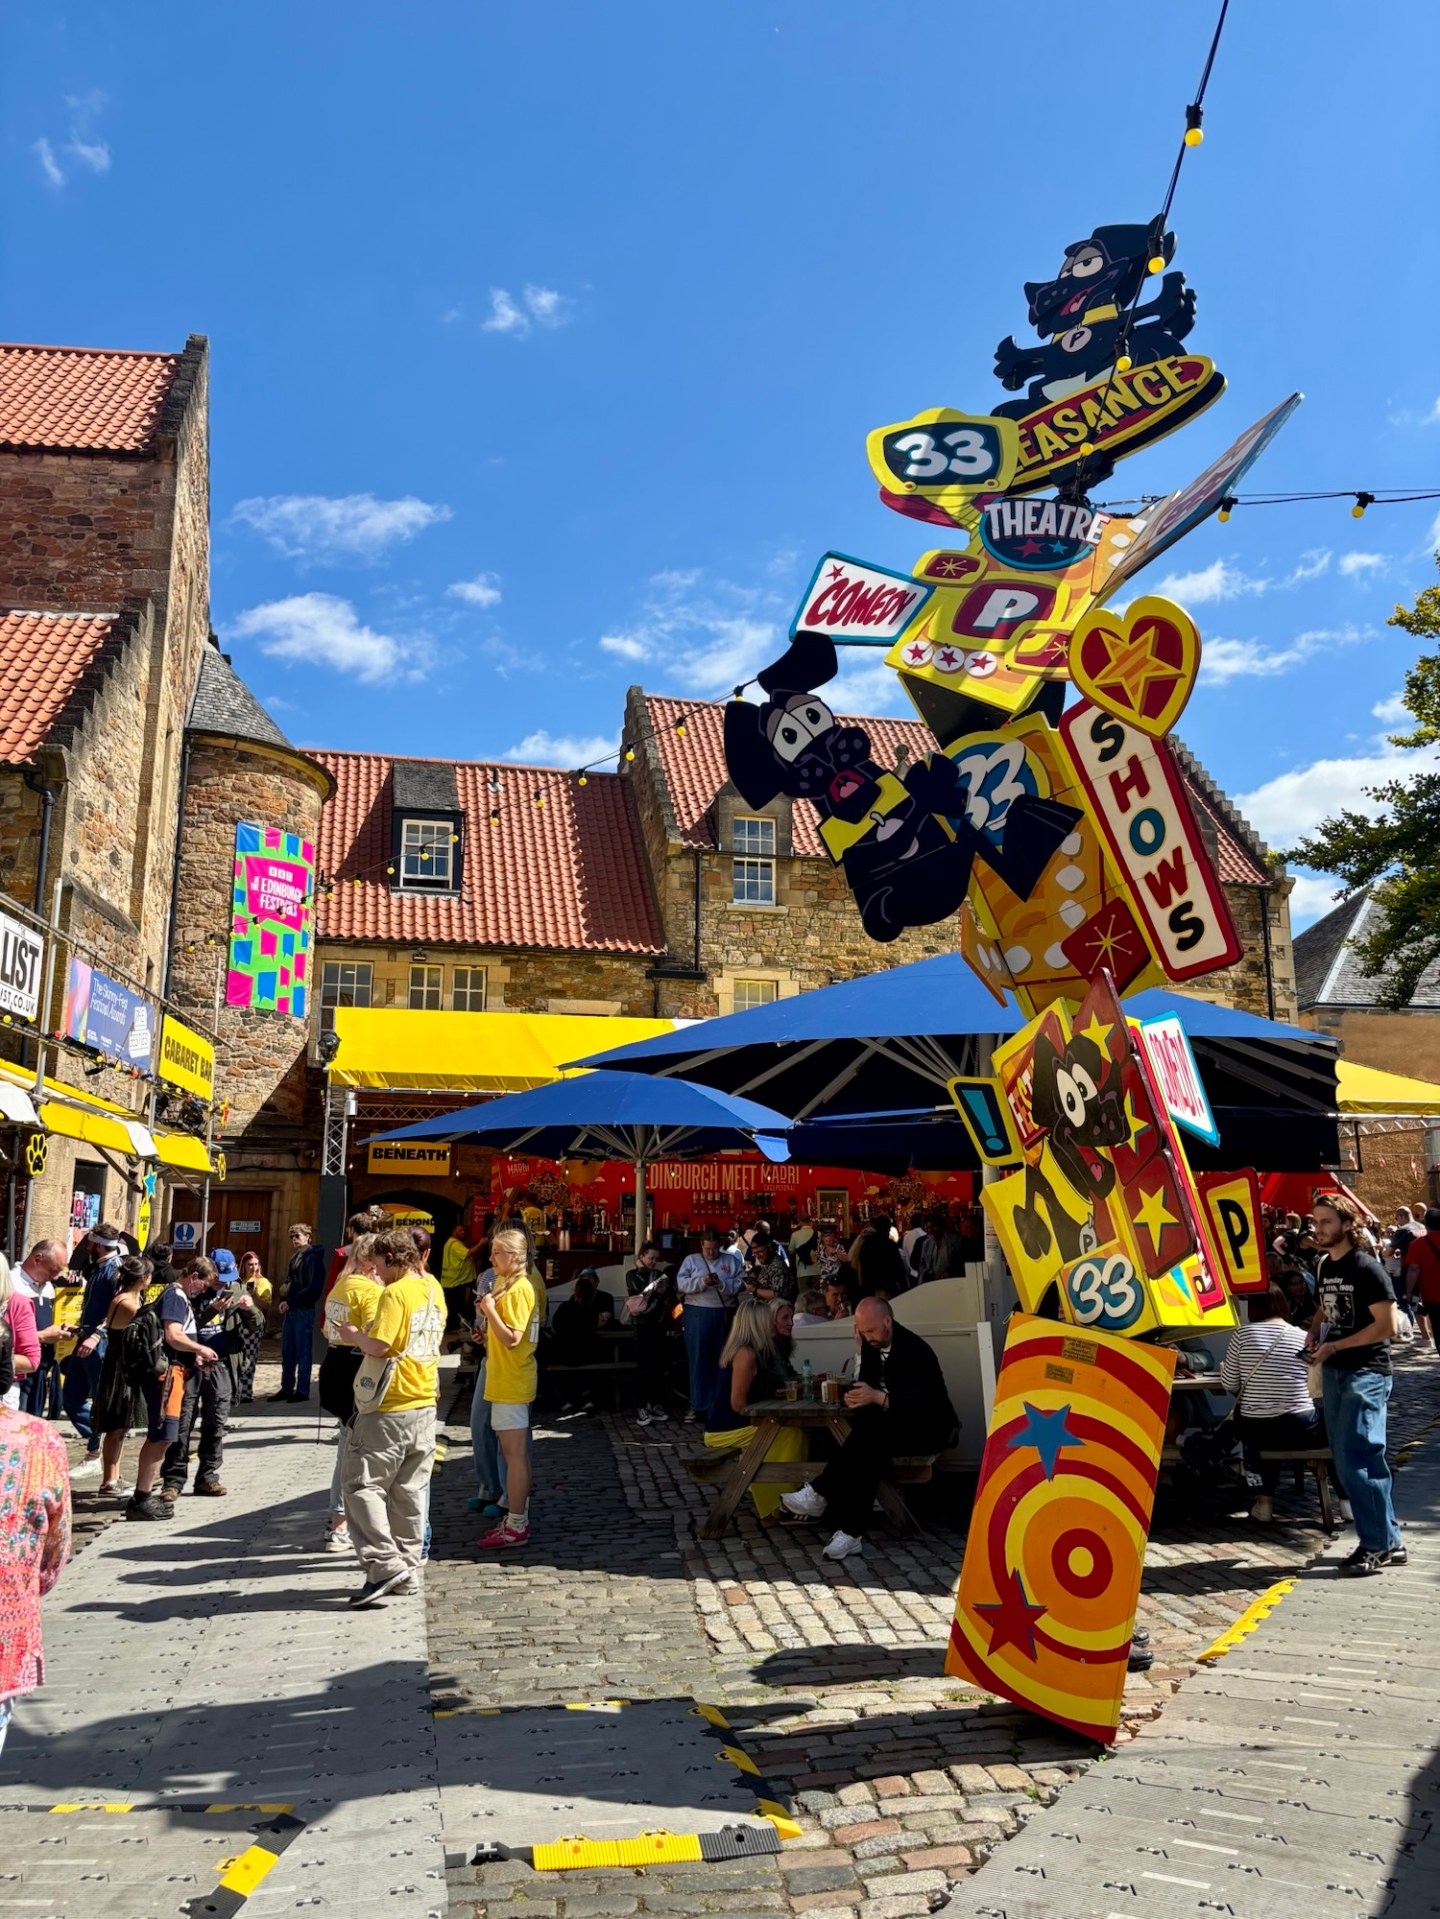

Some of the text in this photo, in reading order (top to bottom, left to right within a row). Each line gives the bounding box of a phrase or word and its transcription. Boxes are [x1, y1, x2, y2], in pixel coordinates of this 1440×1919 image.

[1015, 355, 1198, 473] EASANCE
[893, 429, 995, 477] 33
[984, 501, 1111, 546] THEATRE
[805, 575, 916, 628] COMEDY
[977, 588, 1040, 640] P
[1088, 712, 1205, 952] SHOWS
[260, 877, 303, 903] EDINBURGH
[1, 930, 40, 995] LIST
[164, 1035, 213, 1083] CABARET BAR
[372, 1147, 448, 1162] BENEATH
[721, 1164, 757, 1191] MEET
[1217, 1199, 1250, 1270] P
[1071, 1254, 1137, 1325] 33
[1323, 1276, 1343, 1285] Sunday
